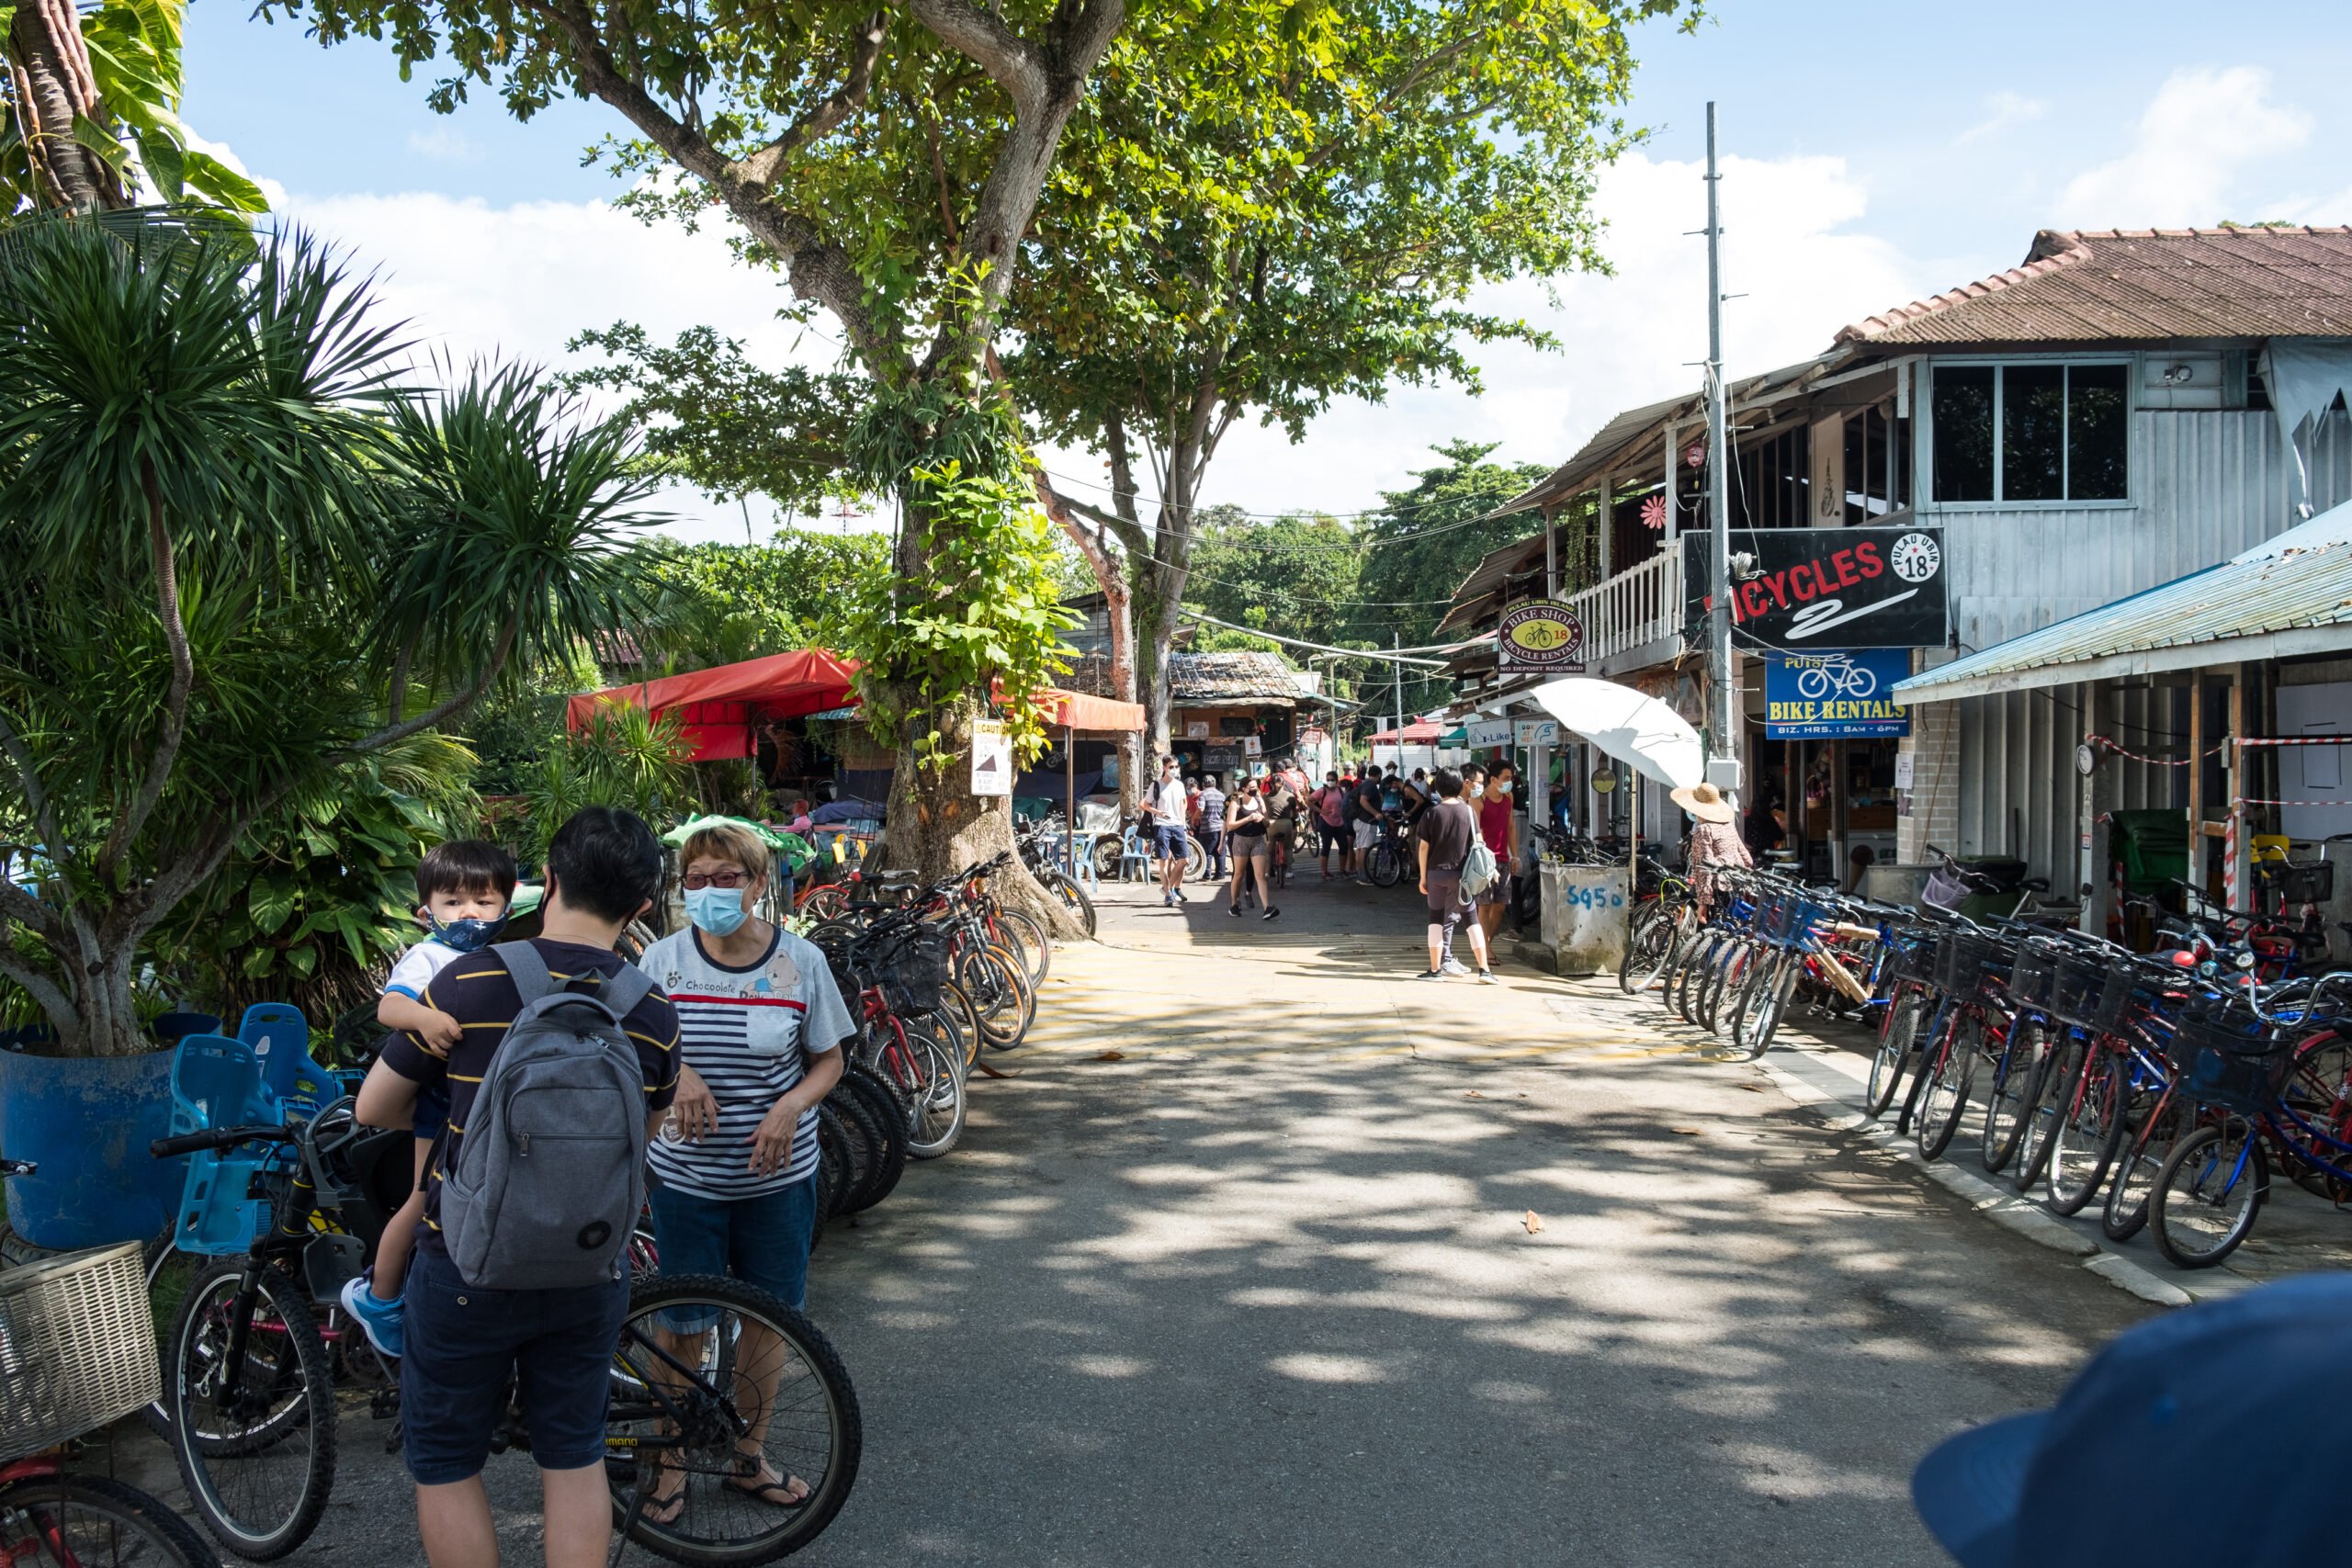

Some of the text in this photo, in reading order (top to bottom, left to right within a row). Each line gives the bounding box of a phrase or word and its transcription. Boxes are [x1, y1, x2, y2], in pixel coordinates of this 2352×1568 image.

[1894, 535, 1939, 566] PULAU UBIN
[1905, 555, 1928, 578] 18
[1702, 541, 1884, 626] ICYCLES
[1508, 601, 1531, 613] PULAU
[1550, 600, 1574, 613] ISLAND
[1508, 609, 1575, 627] BIKE SHOP
[1555, 629, 1568, 640] 18
[1504, 637, 1579, 660] BICYCLE RENTALS
[1770, 700, 1906, 720] BIKE RENTALS
[981, 724, 1011, 734] CAUTION
